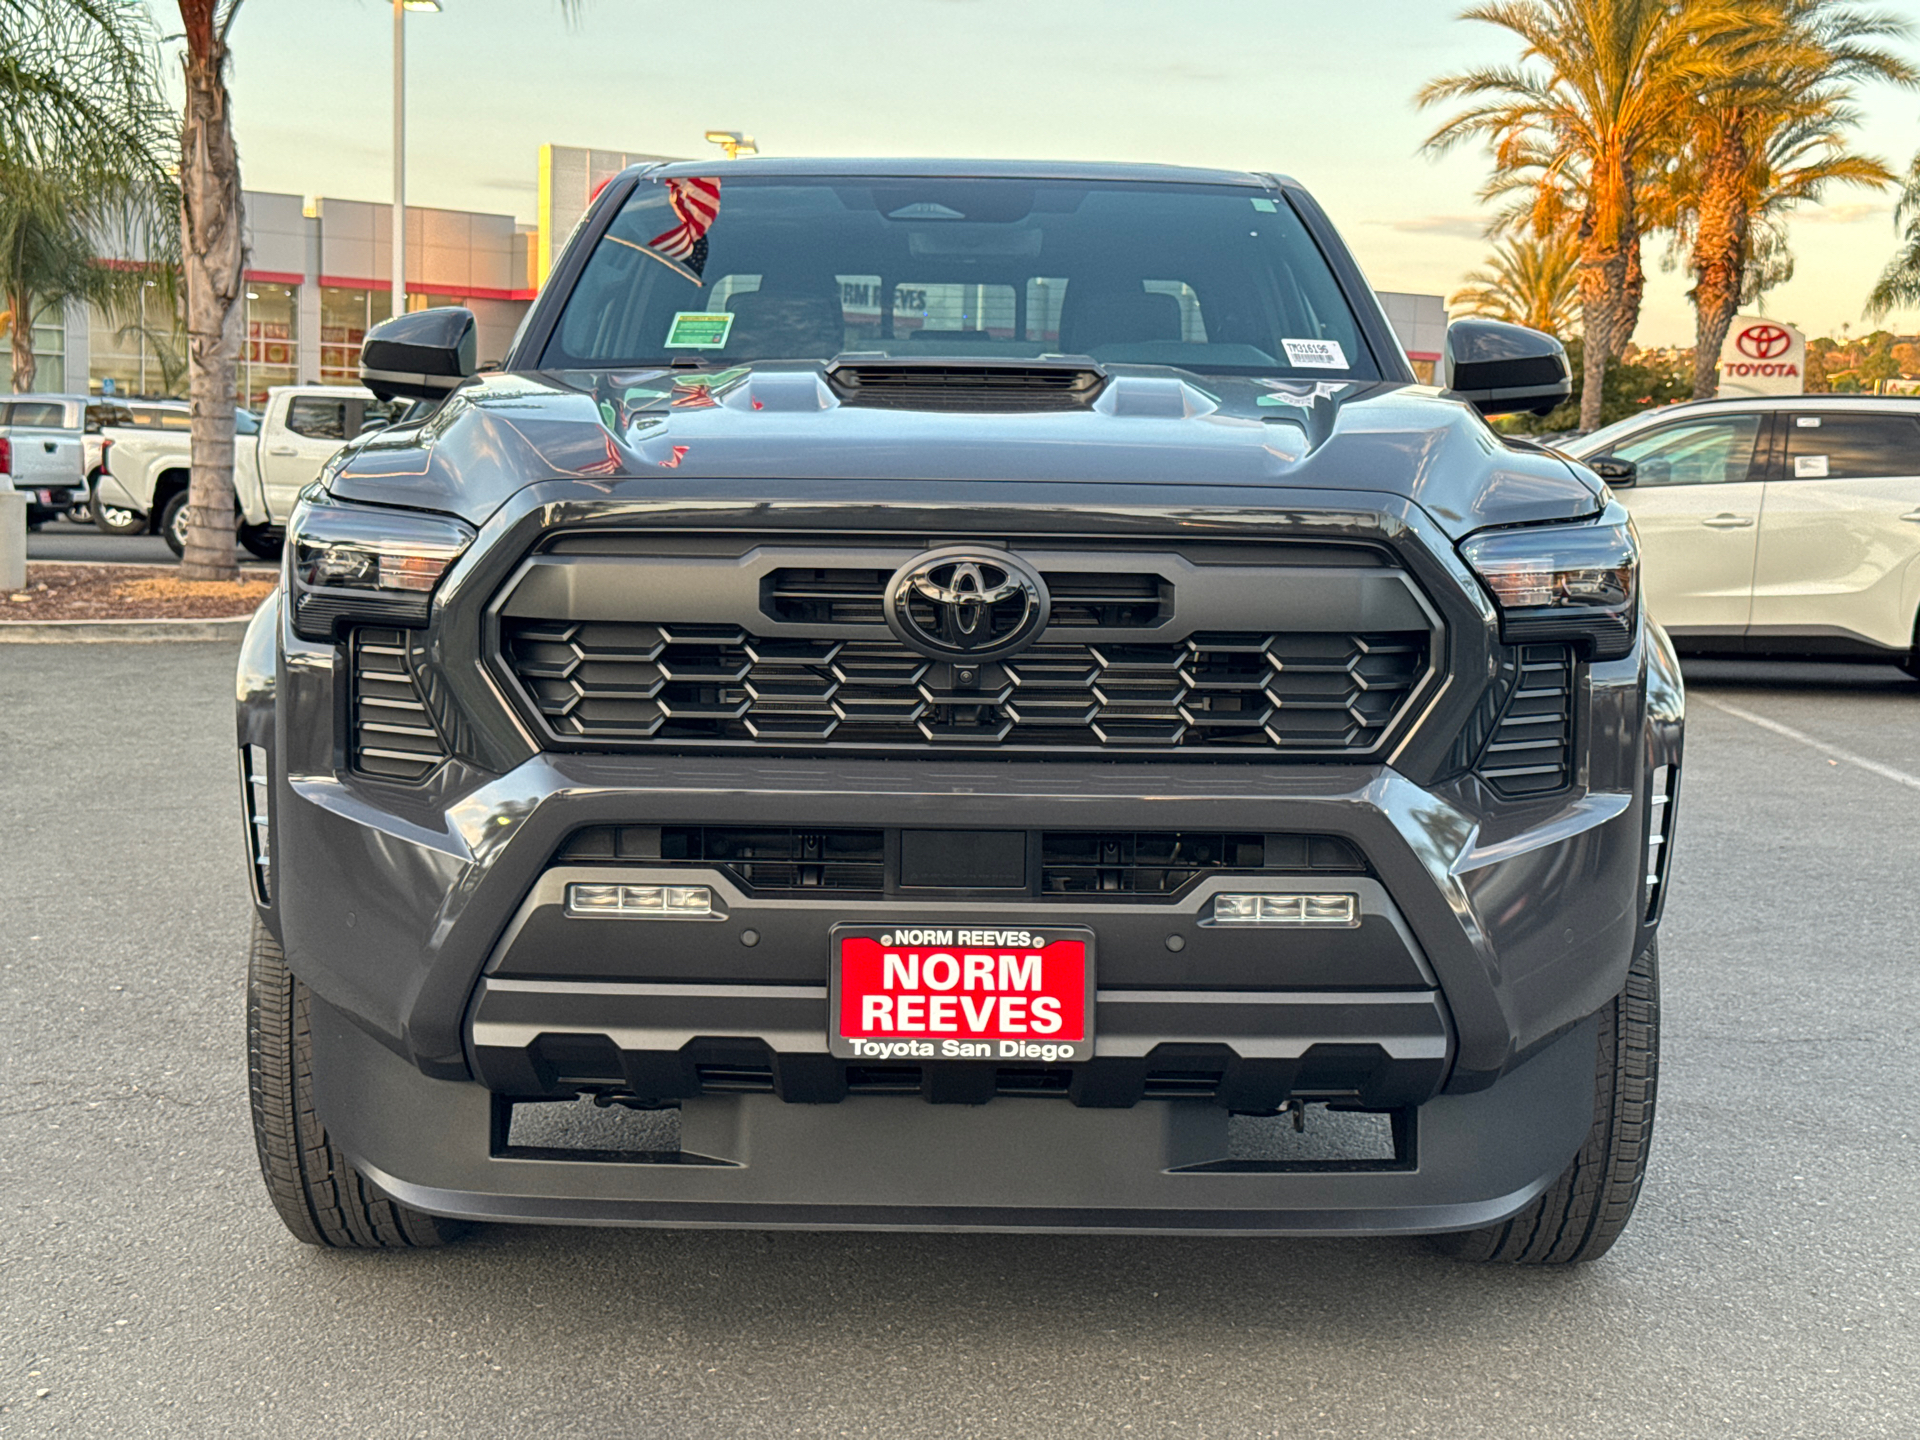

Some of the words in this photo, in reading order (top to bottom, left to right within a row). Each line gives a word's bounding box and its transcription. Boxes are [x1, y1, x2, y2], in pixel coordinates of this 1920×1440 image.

[1724, 363, 1798, 377] TOYOTA
[895, 930, 952, 945] NORM
[958, 931, 1031, 946] REEVES
[883, 953, 1042, 991] NORM
[862, 995, 1063, 1033] REEVES
[849, 1038, 934, 1059] Toyota
[941, 1039, 991, 1057] San
[1000, 1040, 1074, 1062] Diego
